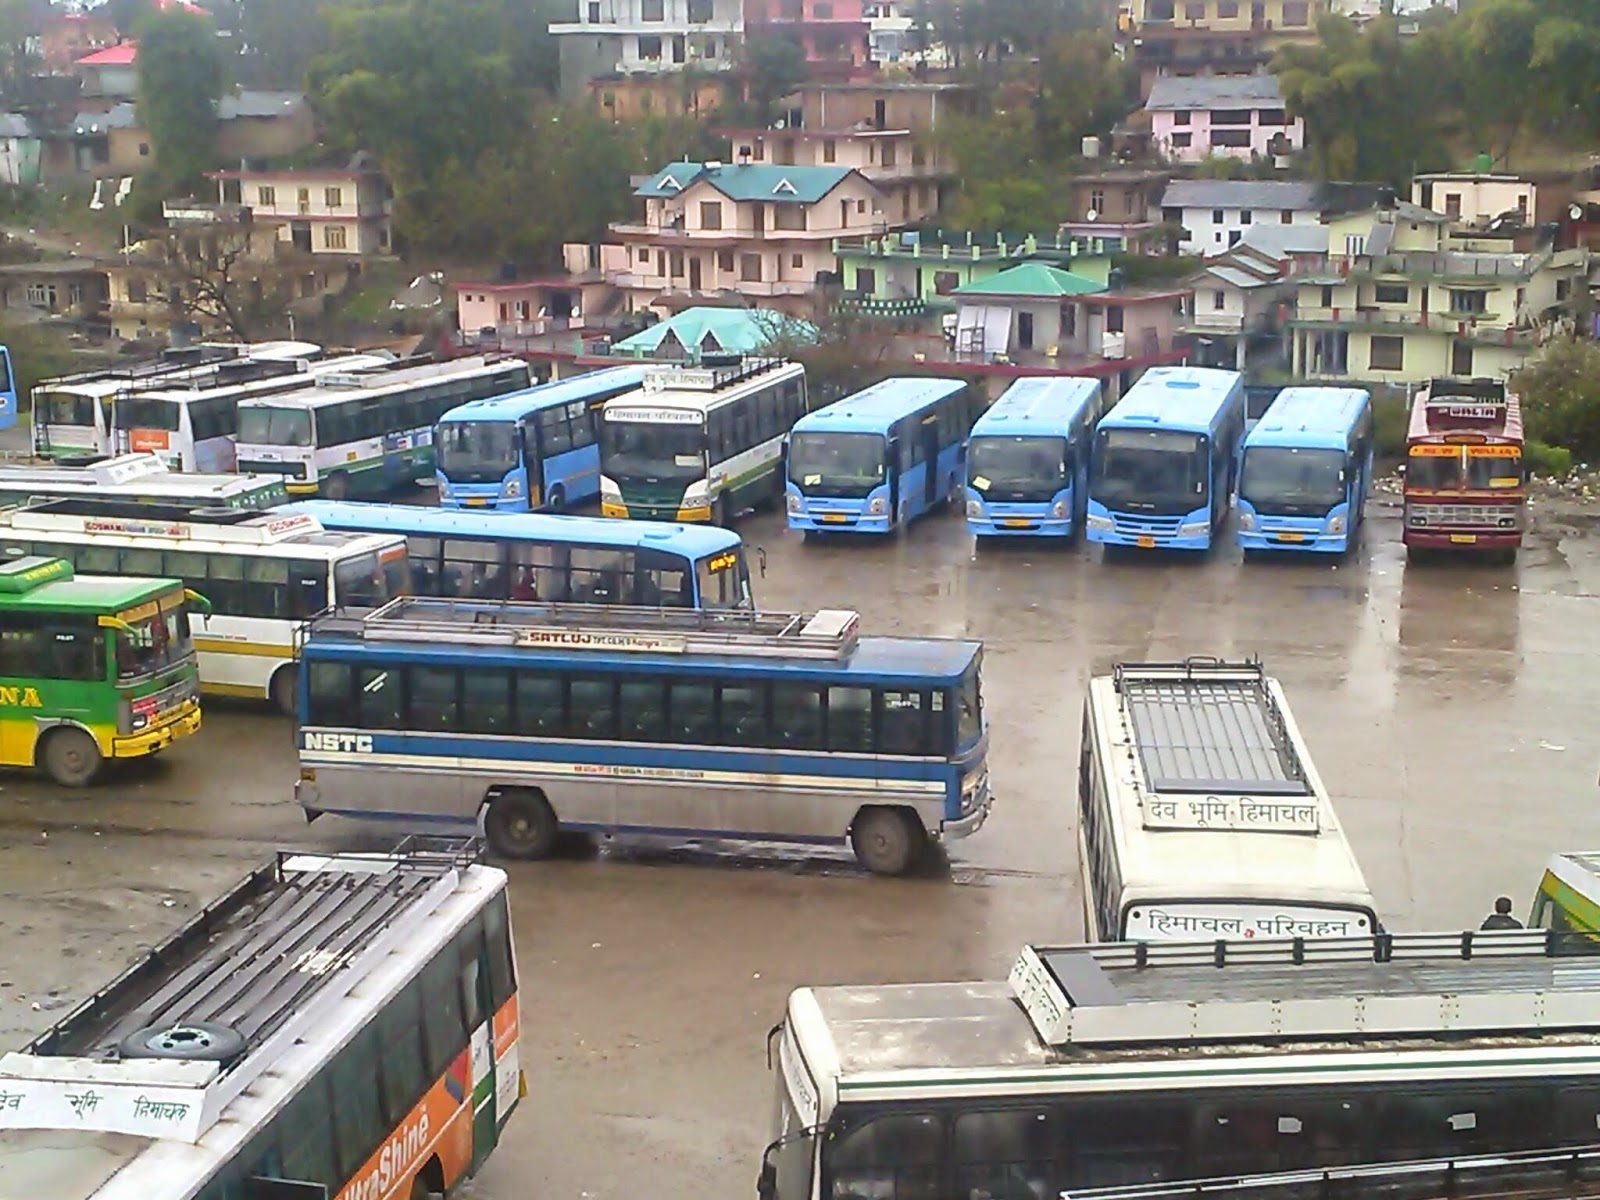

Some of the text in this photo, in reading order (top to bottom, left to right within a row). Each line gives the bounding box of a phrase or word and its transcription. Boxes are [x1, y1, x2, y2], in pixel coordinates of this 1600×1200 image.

[530, 631, 591, 644] SATLUJ
[305, 733, 373, 753] NSTC
[1149, 796, 1318, 827] देव भूमि हिमाचल
[1148, 909, 1351, 937] हिमाचल परिवहन
